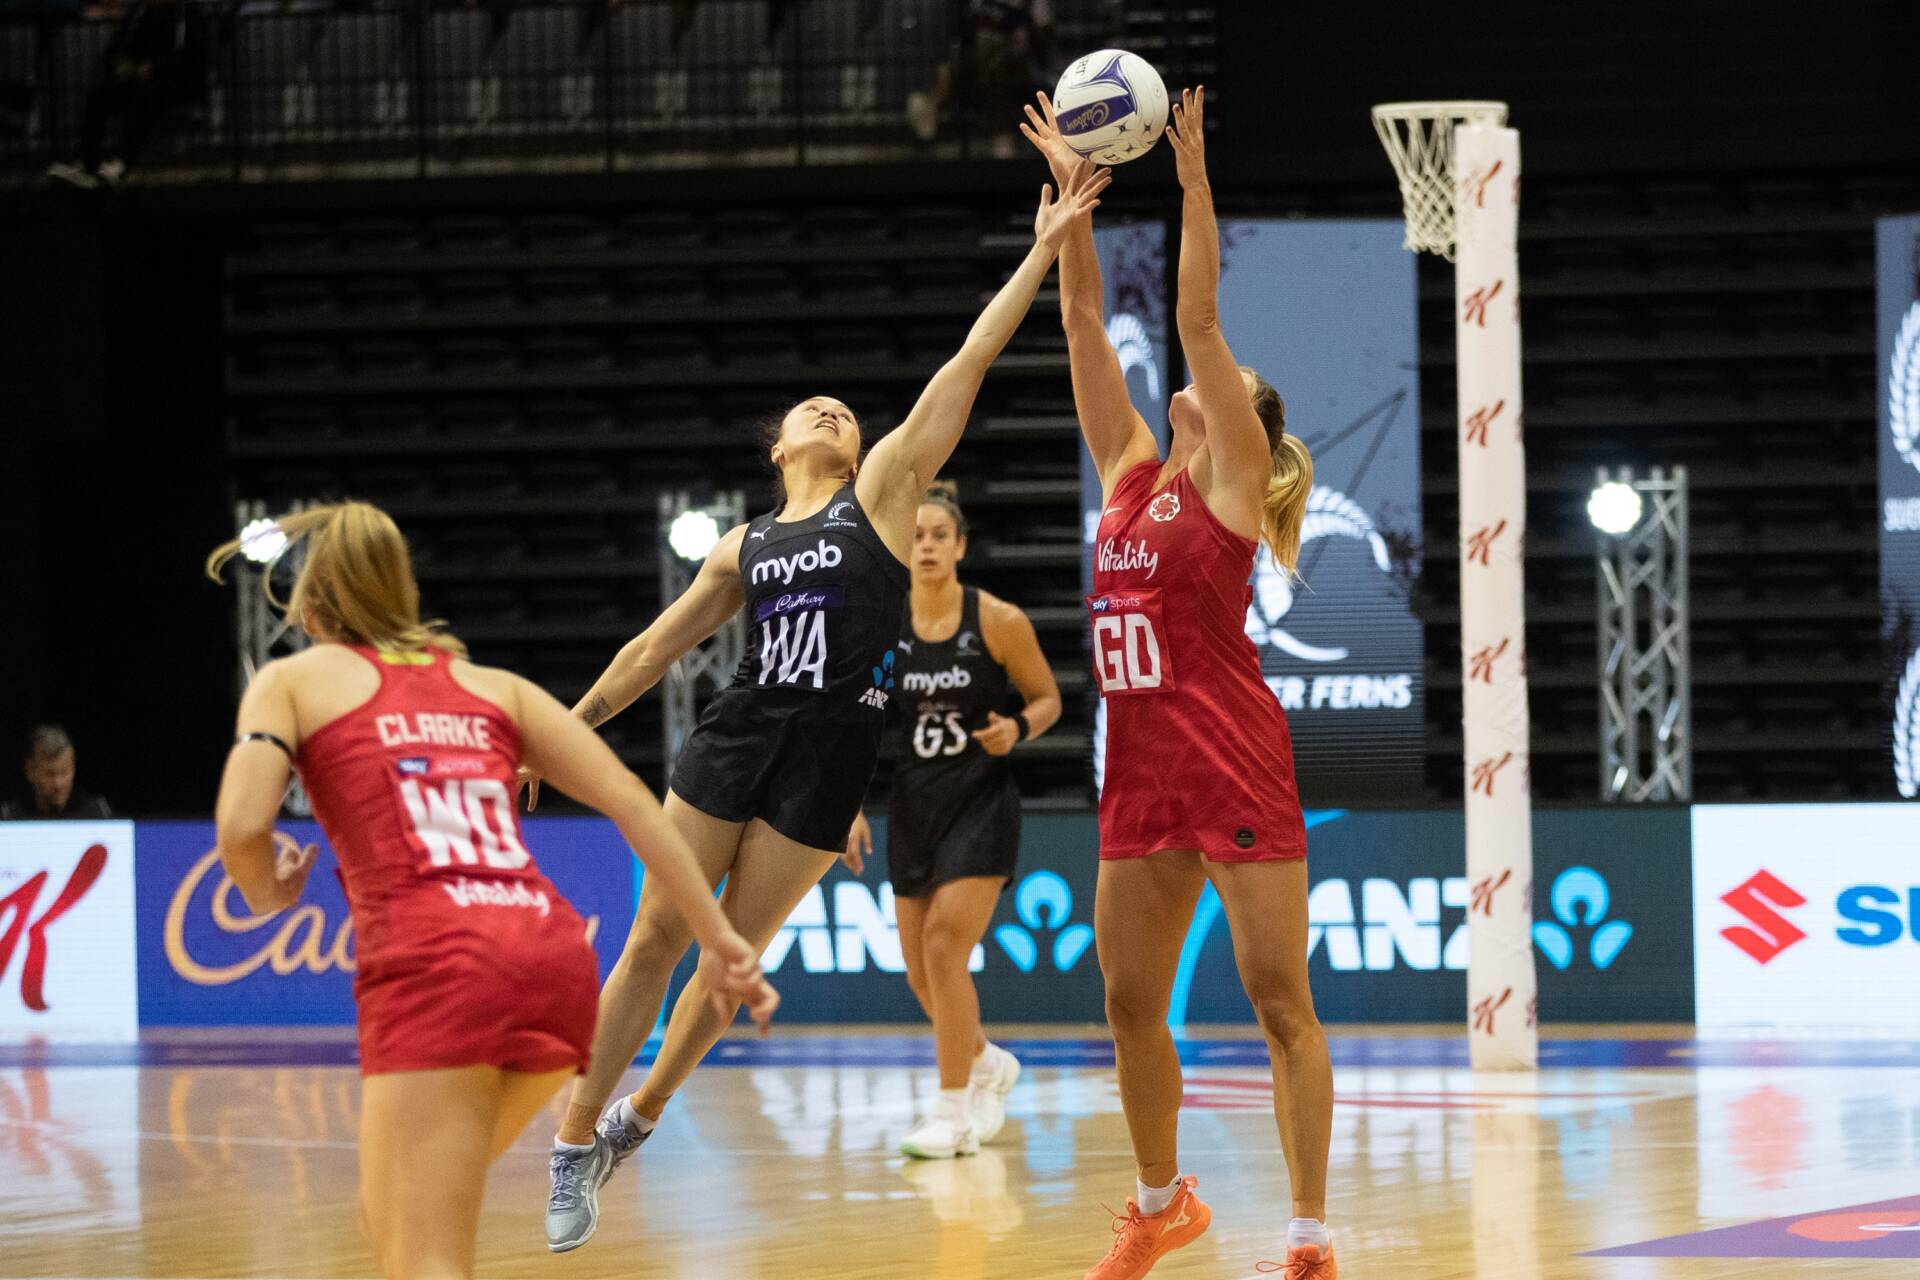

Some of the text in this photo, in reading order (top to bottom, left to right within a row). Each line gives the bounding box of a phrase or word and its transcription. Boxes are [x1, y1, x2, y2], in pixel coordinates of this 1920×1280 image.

[751, 539, 842, 585] myob
[1097, 537, 1158, 580] Vitality
[775, 592, 825, 612] Cadbury
[1092, 597, 1141, 612] sky sports
[758, 610, 827, 689] WA
[1094, 613, 1162, 692] GD
[903, 664, 971, 696] myob
[1310, 674, 1413, 709] FERNS
[376, 711, 492, 750] CLARKE
[913, 711, 967, 758] GS
[400, 778, 531, 869] WD
[759, 881, 984, 972] AN
